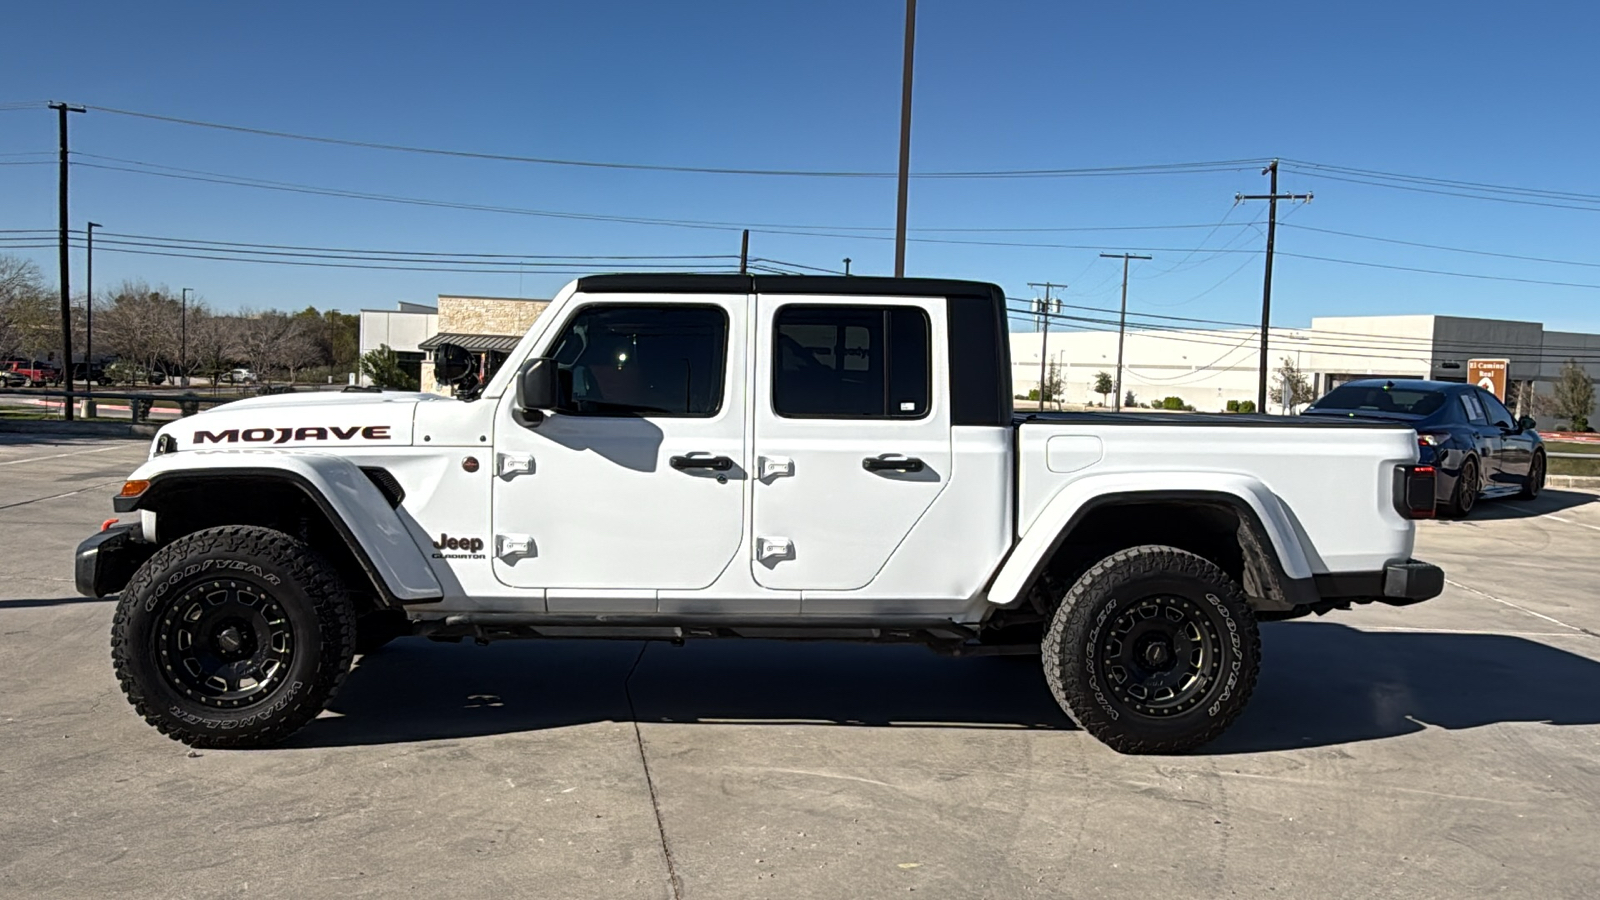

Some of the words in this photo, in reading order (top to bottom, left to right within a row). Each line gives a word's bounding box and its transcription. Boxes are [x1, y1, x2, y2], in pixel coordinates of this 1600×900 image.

[193, 426, 391, 444] MOJAVE
[432, 533, 484, 553] Jeep
[145, 559, 281, 612] GOODYEAR
[1086, 599, 1120, 721] WRANGLER
[1206, 593, 1243, 716] GOODYEAR
[169, 680, 303, 730] WRANGLER
